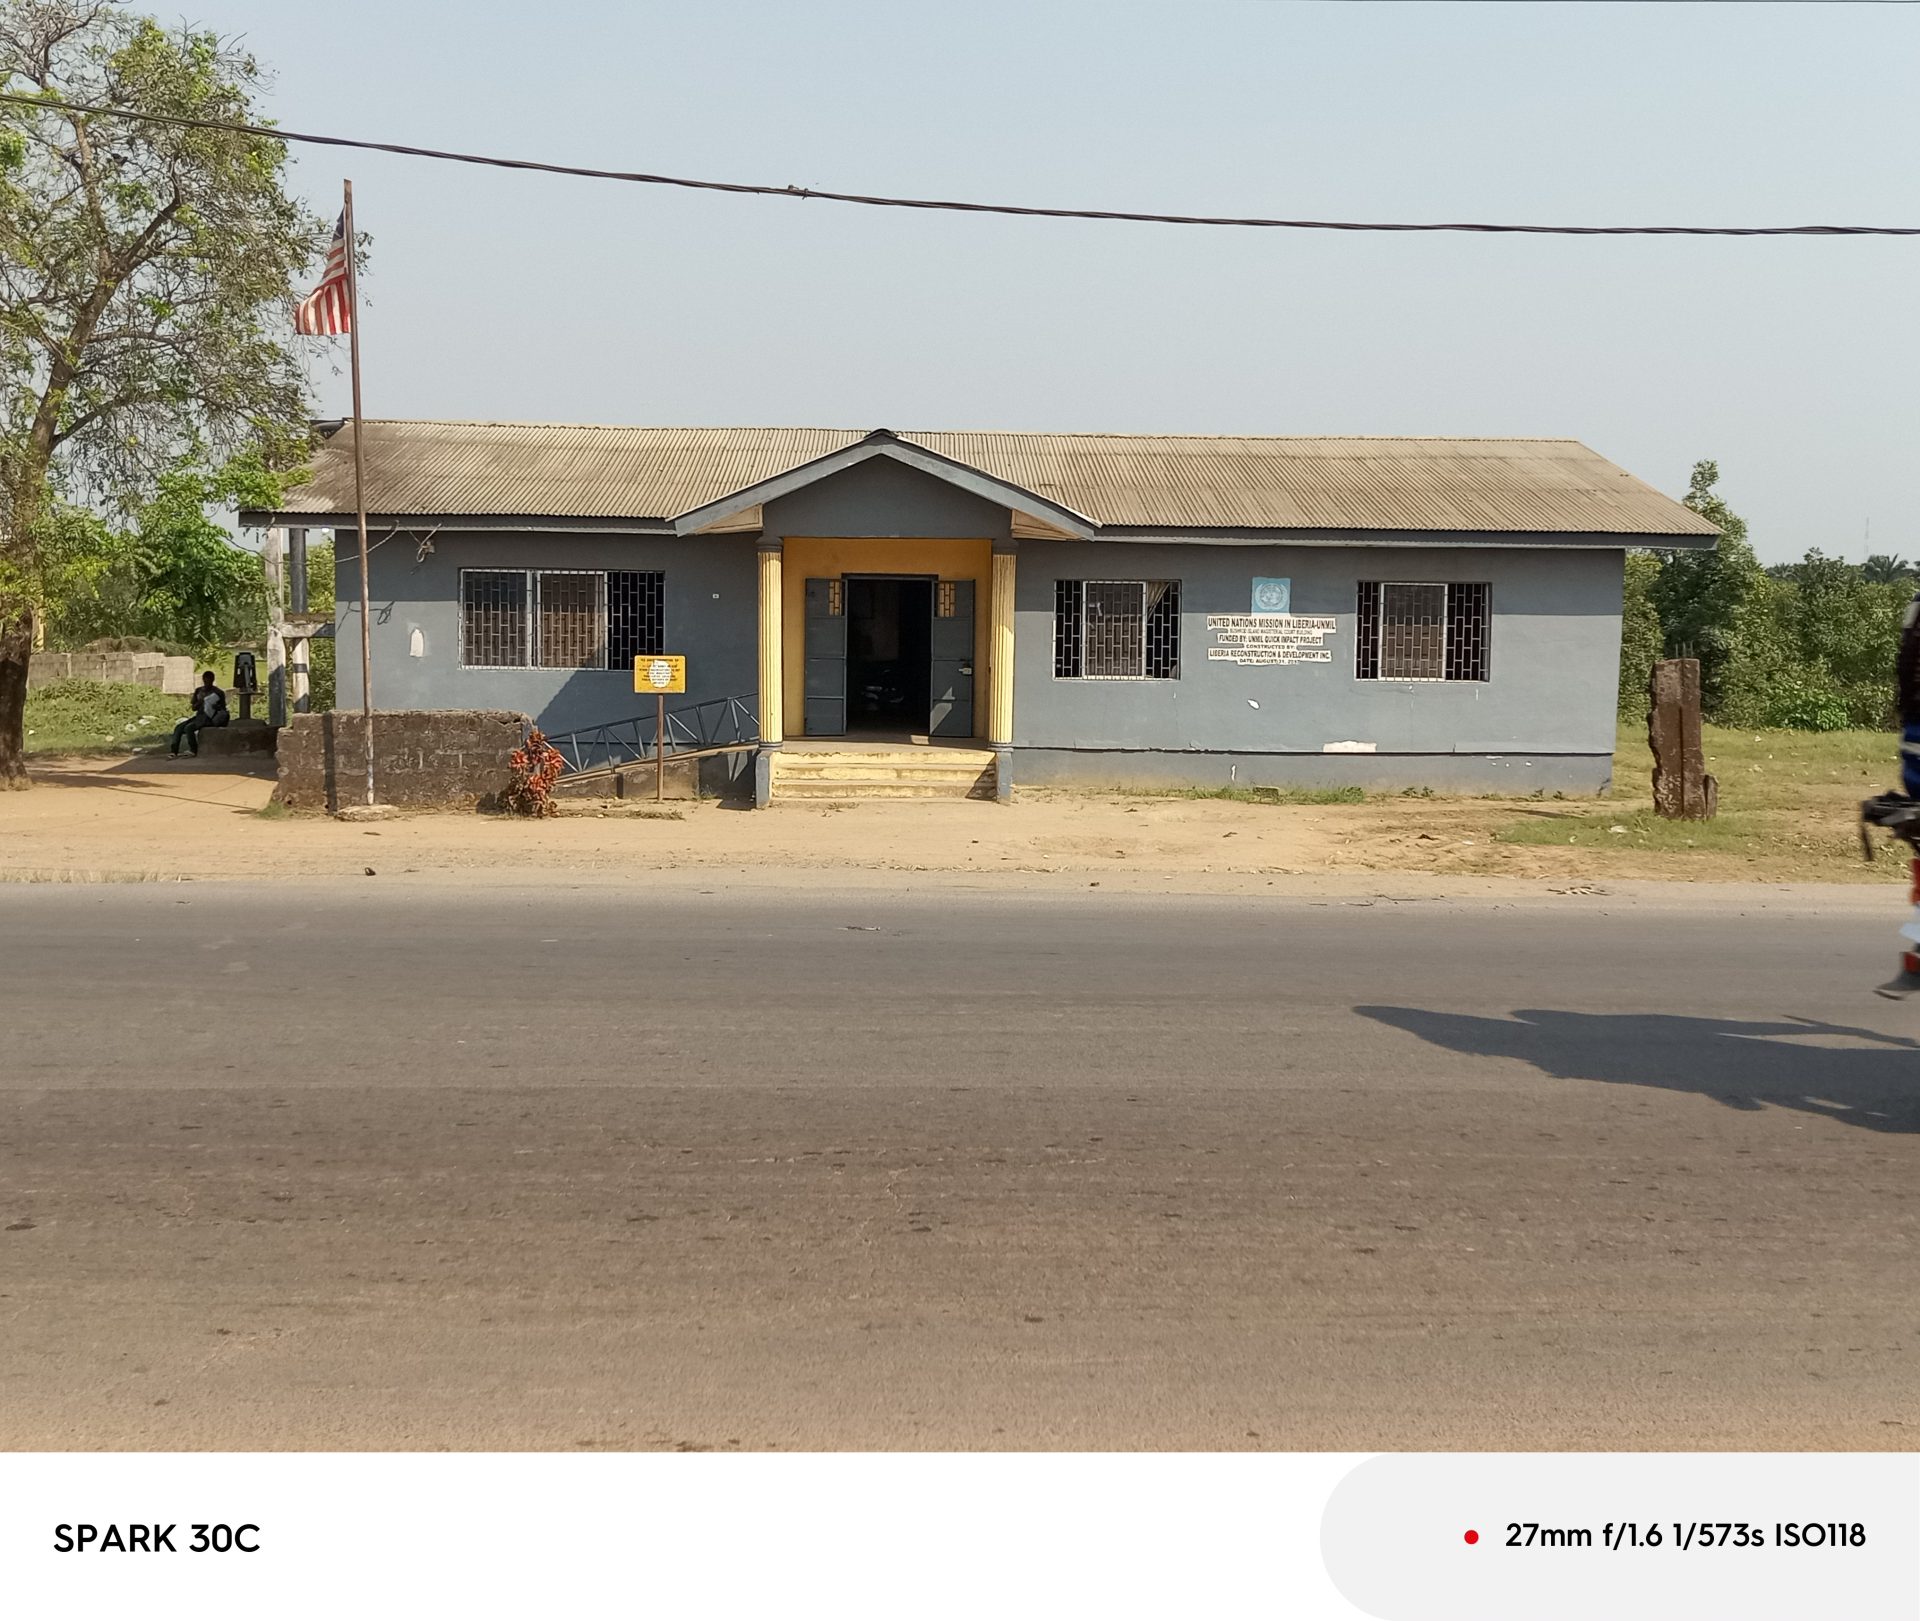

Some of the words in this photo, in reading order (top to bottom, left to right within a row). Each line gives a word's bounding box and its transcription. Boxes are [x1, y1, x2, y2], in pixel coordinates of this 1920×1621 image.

[1208, 617, 1230, 627] UNITED
[1231, 618, 1257, 628] NATIONS
[1259, 618, 1283, 628] MISSION
[1284, 619, 1291, 628] IN
[1292, 619, 1336, 629] LIBERIA-UNMIL
[1219, 634, 1238, 642] FUNDED
[1239, 635, 1247, 643] BY:
[1248, 635, 1263, 643] UNMIL
[1265, 635, 1280, 643] QUICK
[1281, 636, 1299, 644] IMPACT
[1300, 636, 1322, 644] PROJECT
[1209, 649, 1229, 657] LIBERIA
[1230, 650, 1276, 658] RECONSTRUCTION
[1282, 651, 1319, 659] DEVELOPMENT
